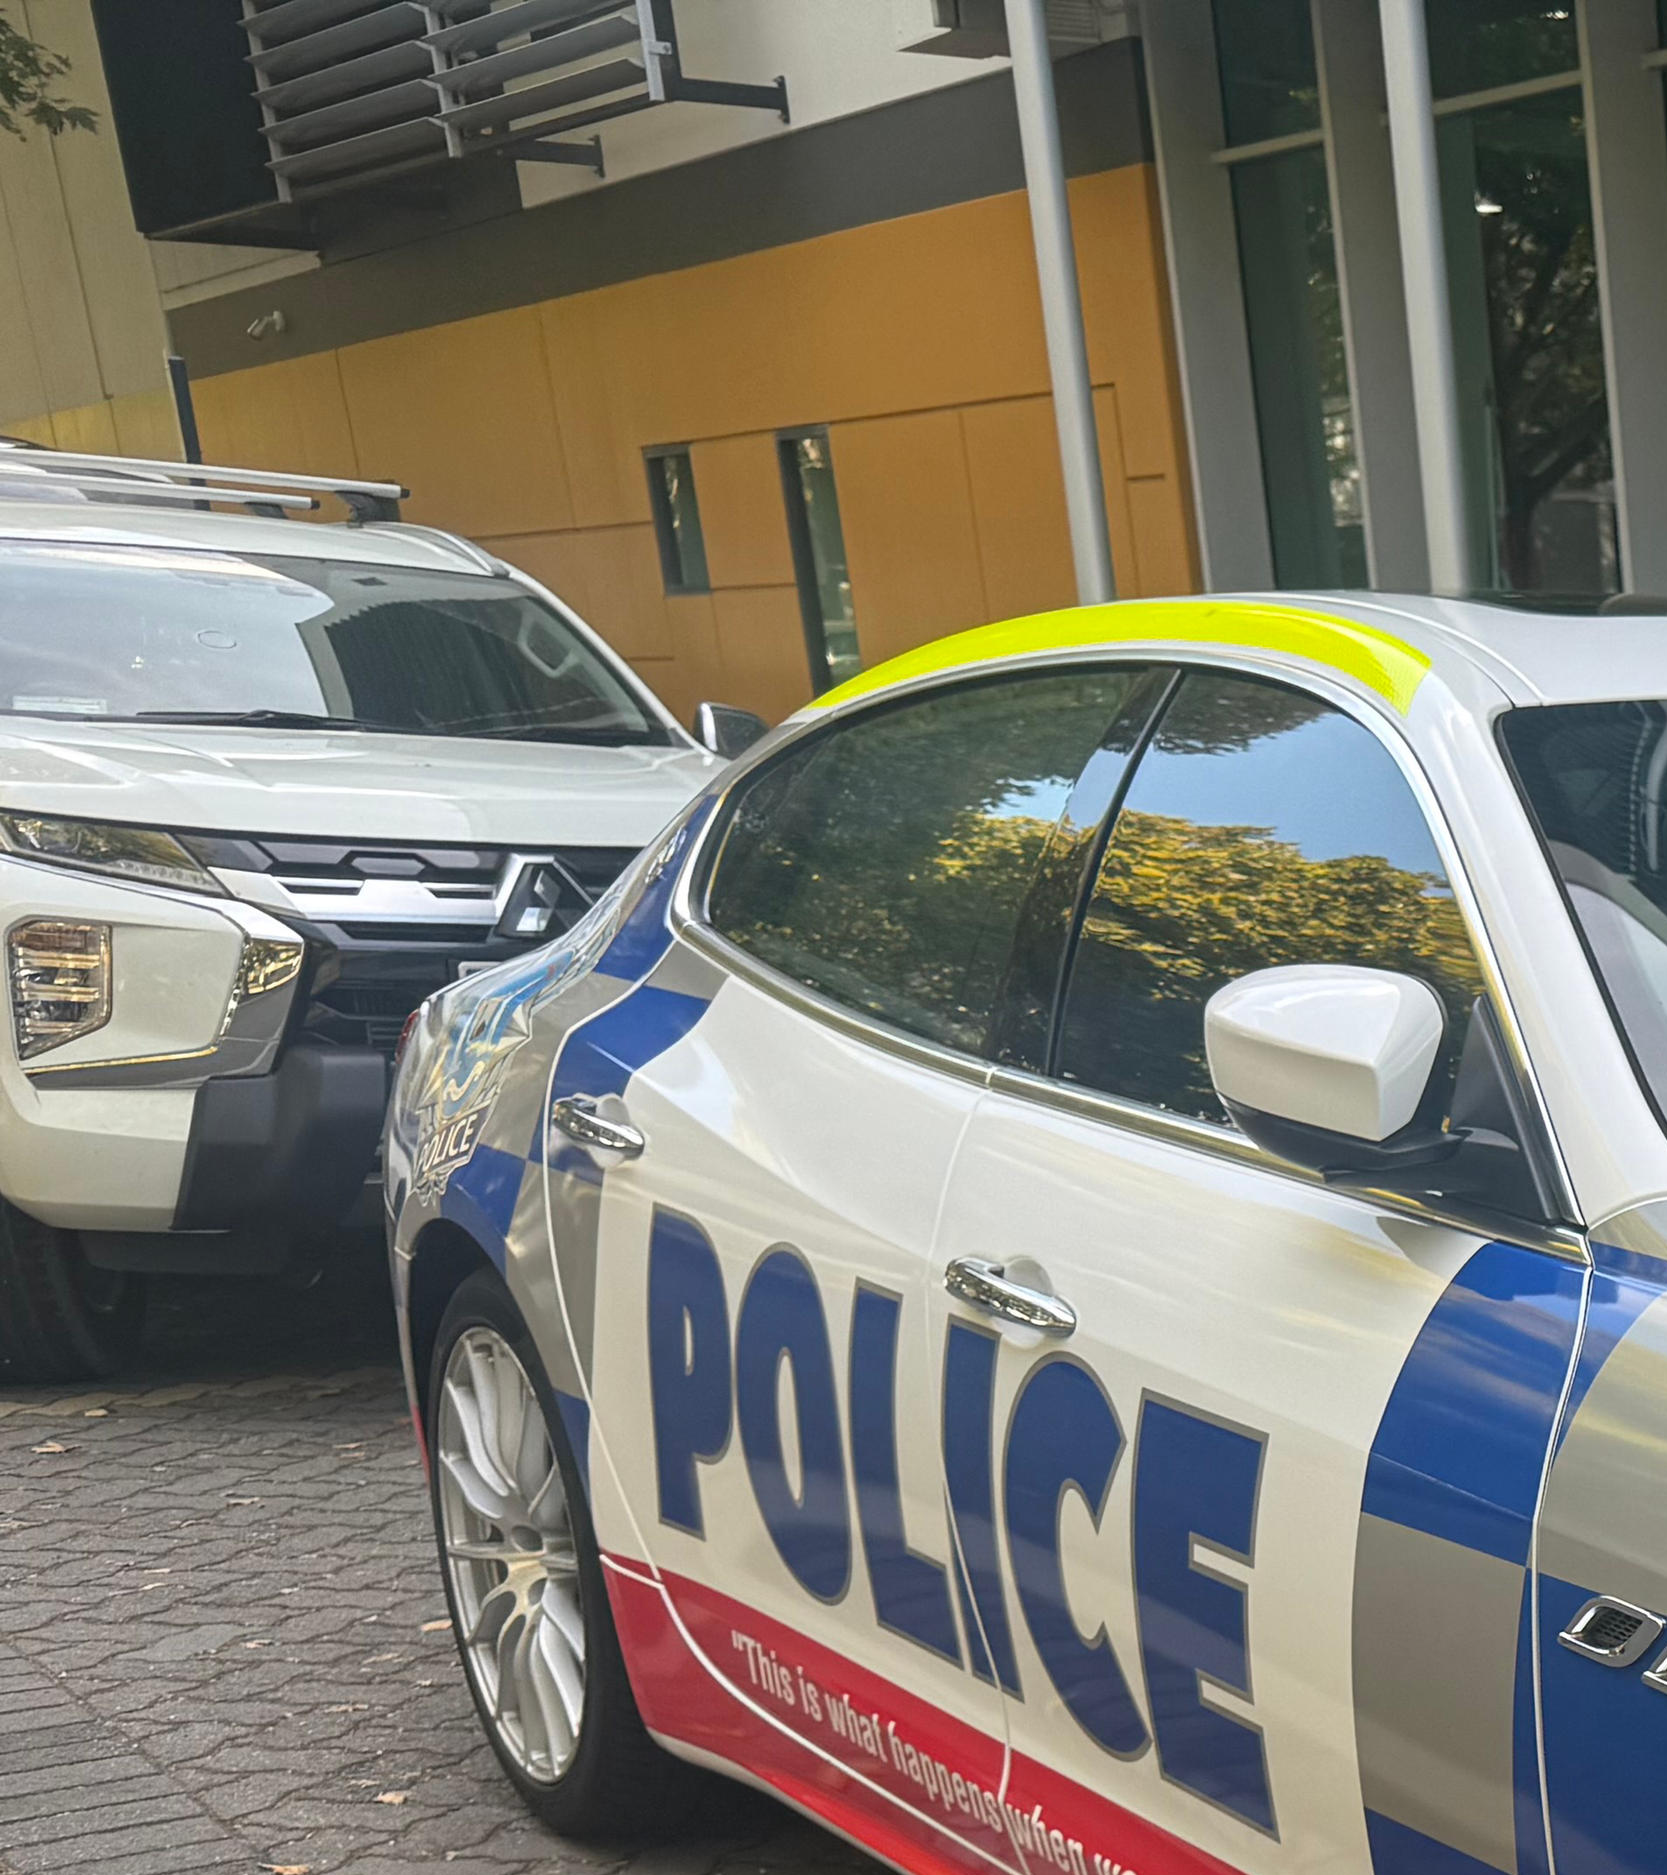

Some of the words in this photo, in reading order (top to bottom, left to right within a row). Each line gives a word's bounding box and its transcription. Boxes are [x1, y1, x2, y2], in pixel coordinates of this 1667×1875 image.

[646, 1202, 1281, 1844] POLICE
[731, 1629, 796, 1706] "This
[798, 1665, 823, 1722] is
[825, 1693, 888, 1764] what
[888, 1720, 1003, 1833] happens
